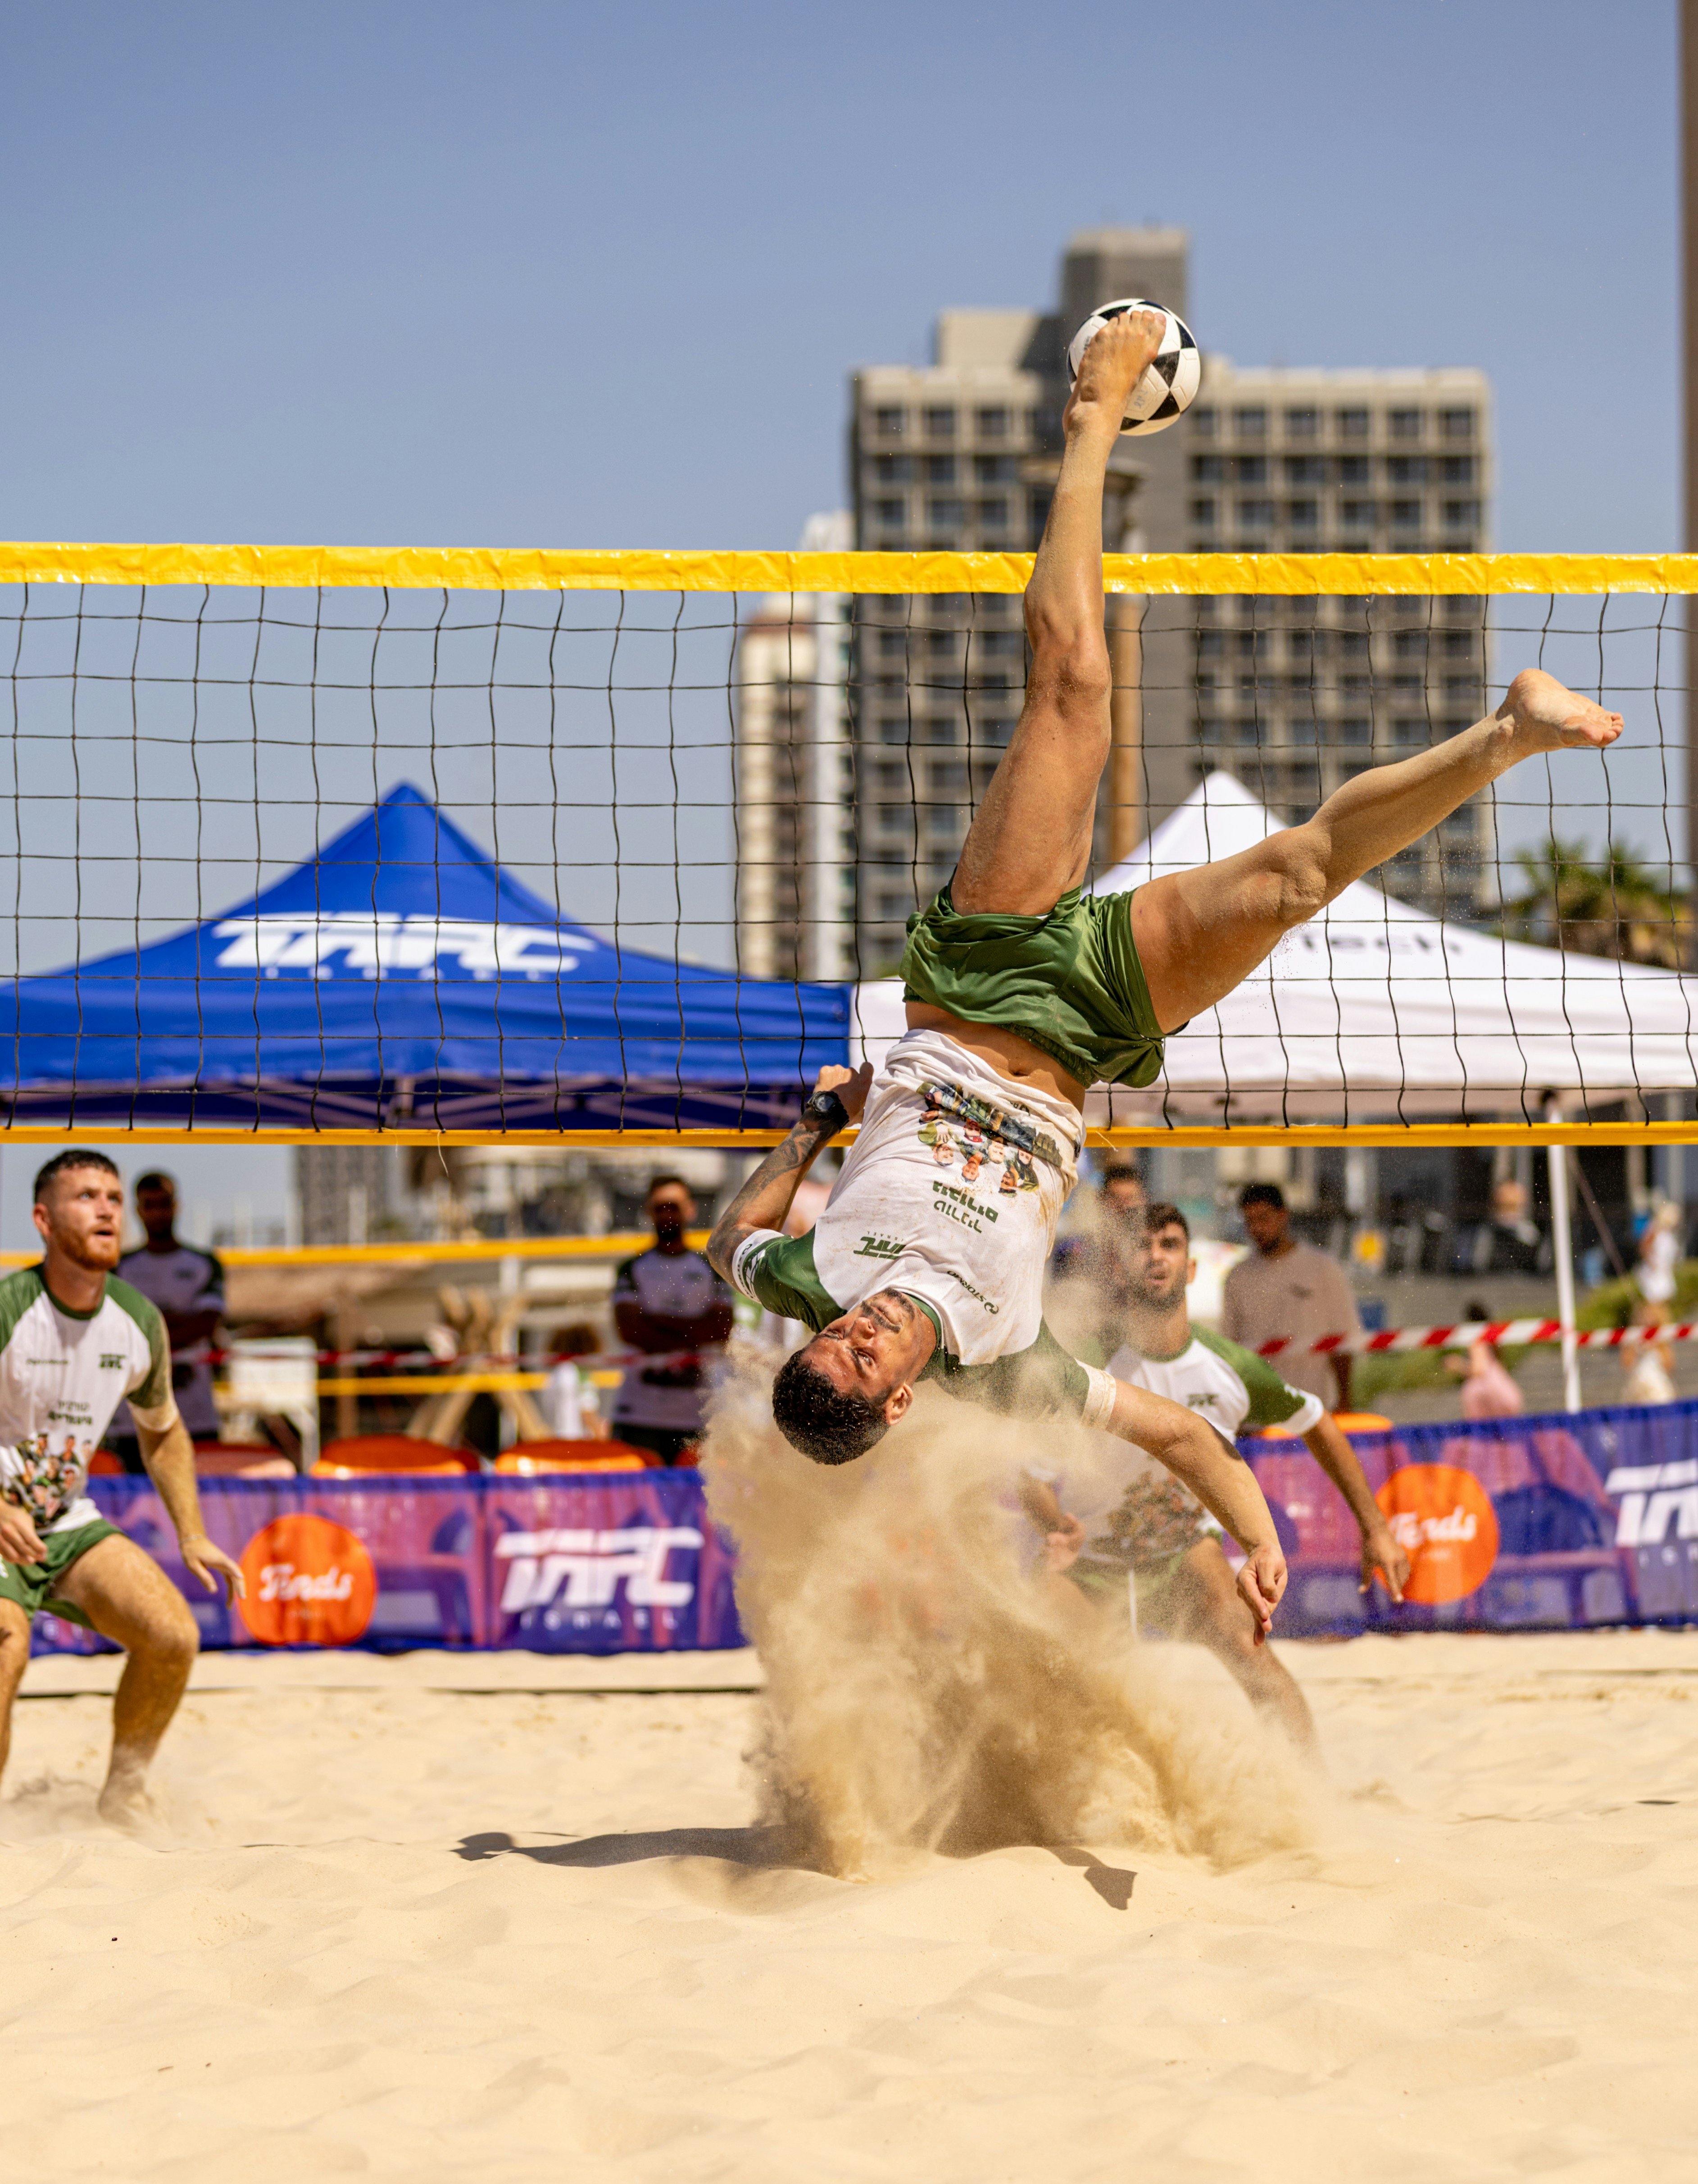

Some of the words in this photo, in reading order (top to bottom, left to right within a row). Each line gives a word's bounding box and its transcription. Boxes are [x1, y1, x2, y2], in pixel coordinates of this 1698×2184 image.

[933, 1200, 982, 1233] טורניר
[867, 1231, 903, 1242] ISRAEL
[947, 1271, 987, 1303] STORMO
